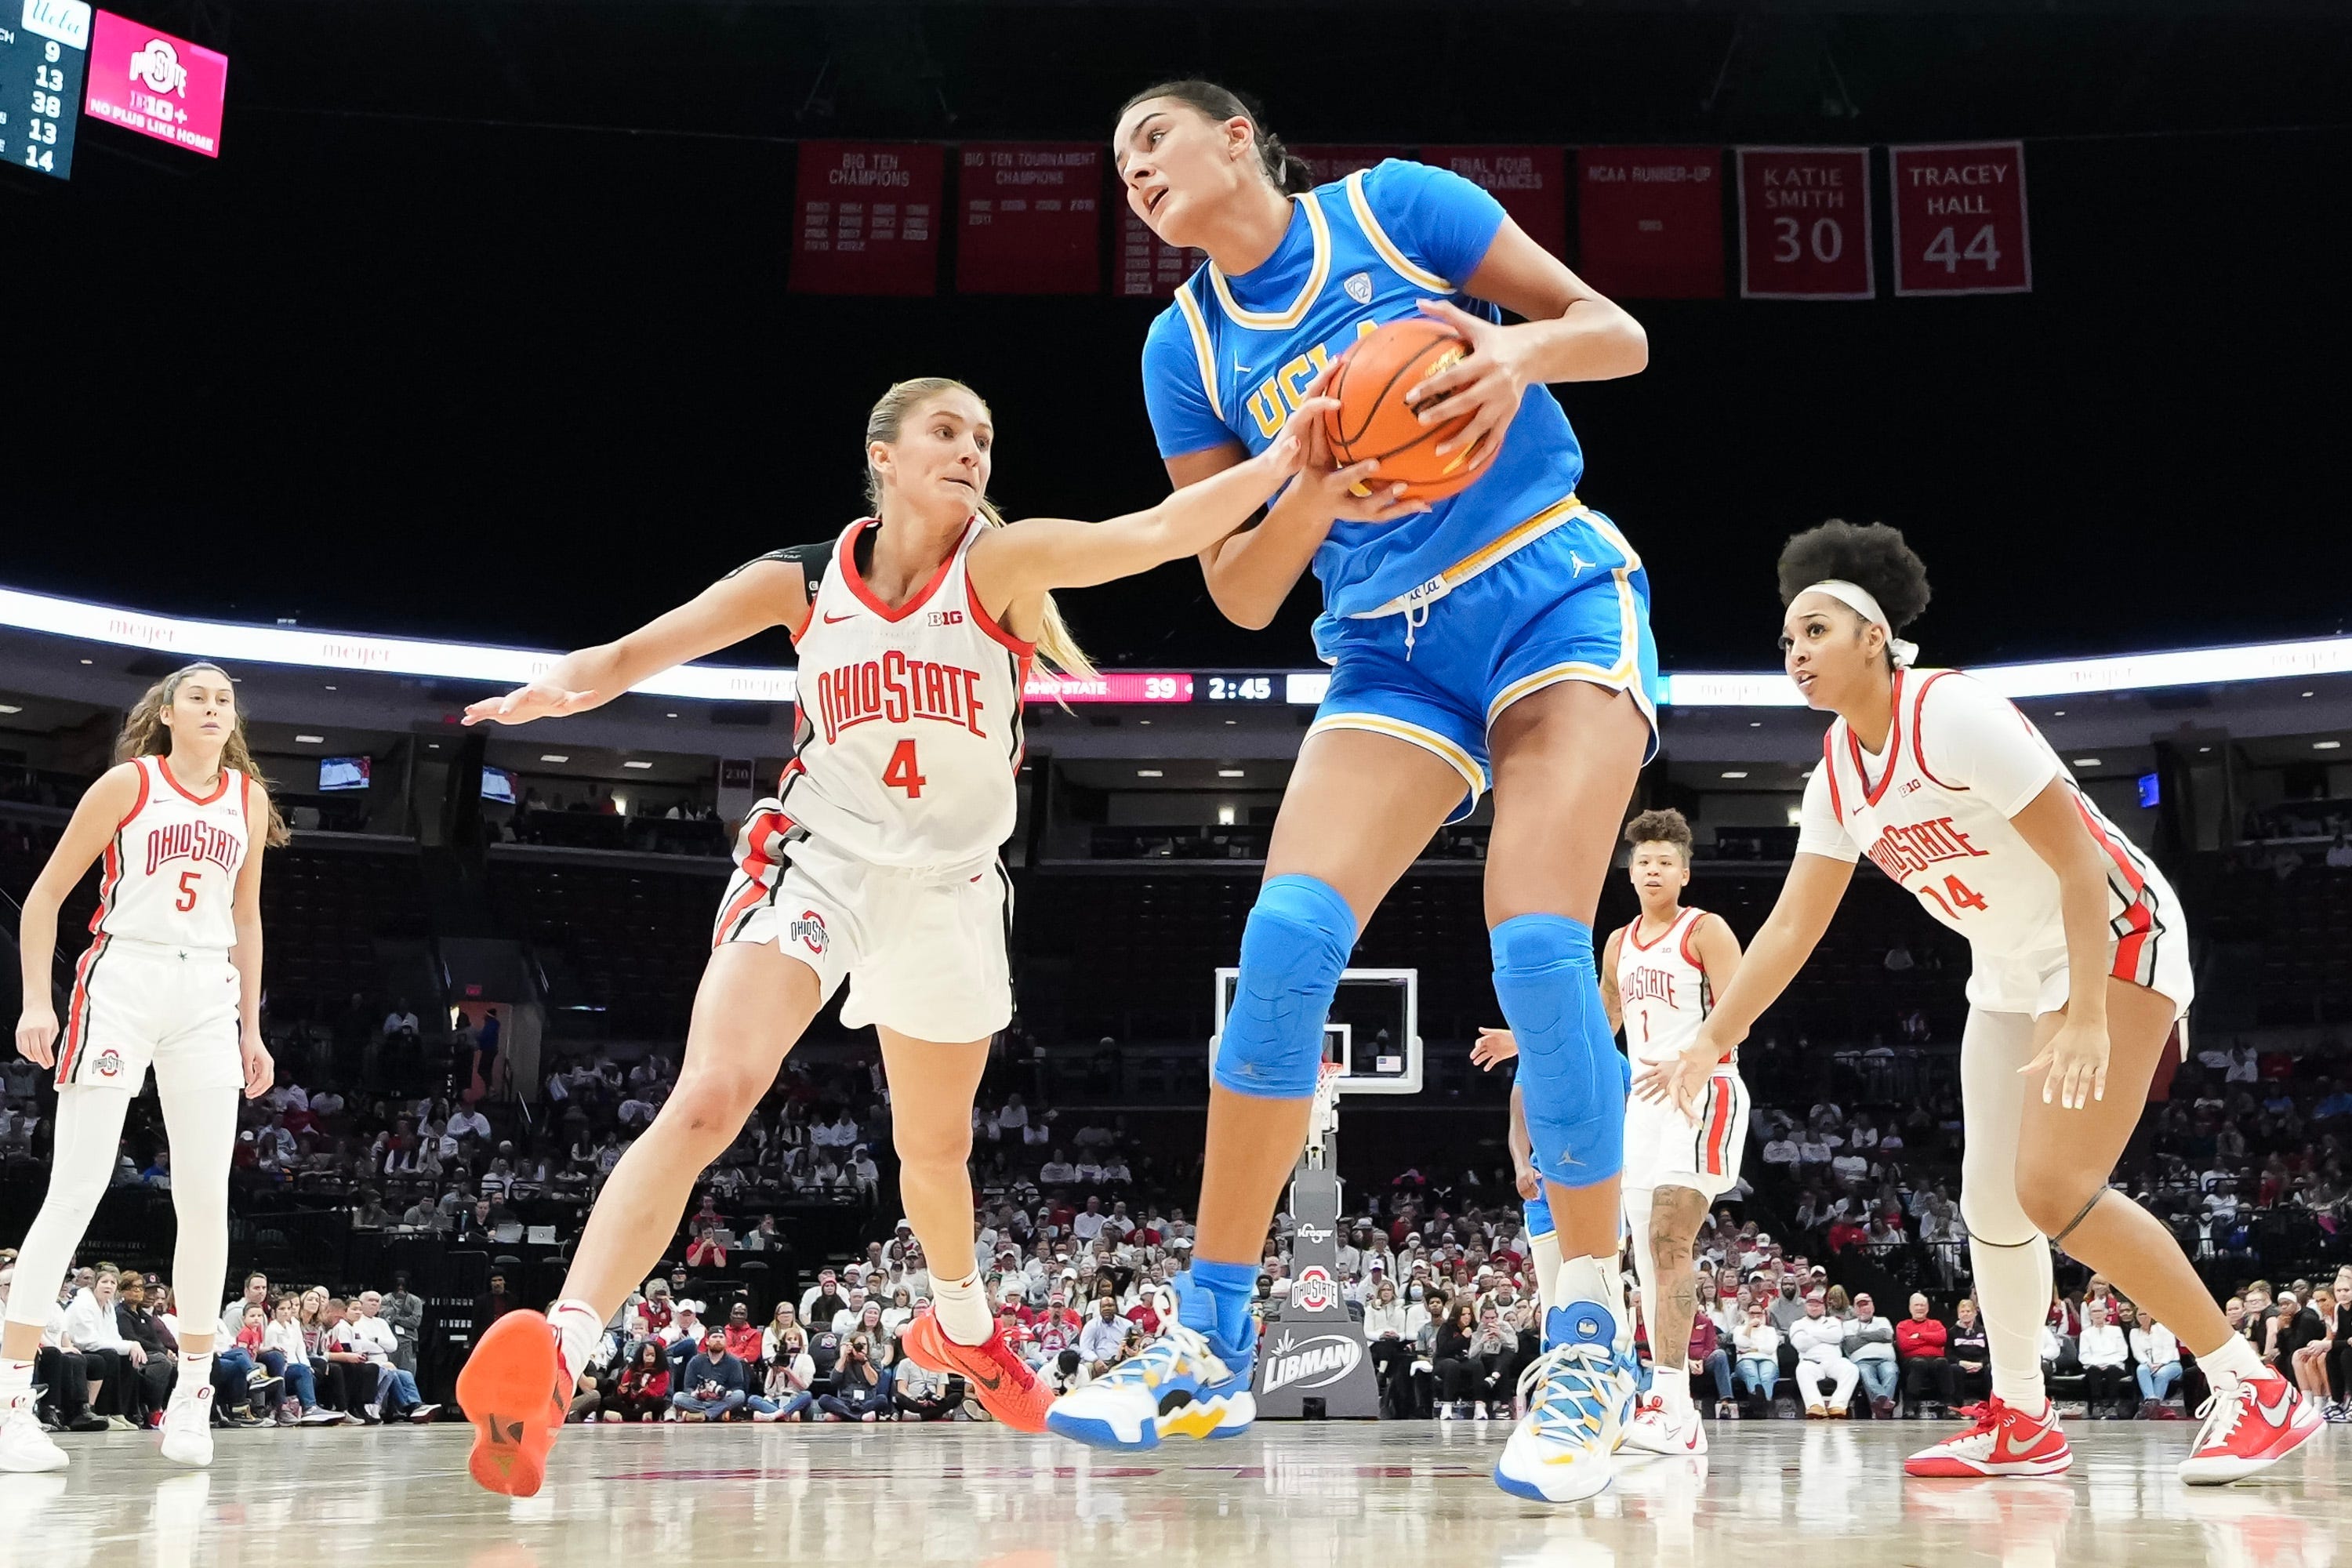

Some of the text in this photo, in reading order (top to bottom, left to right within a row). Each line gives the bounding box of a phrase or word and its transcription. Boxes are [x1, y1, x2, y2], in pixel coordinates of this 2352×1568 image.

[45, 41, 60, 63] 9
[35, 65, 64, 92] 13
[31, 91, 60, 118] 38
[28, 118, 57, 145] 13
[90, 98, 213, 151] NO PLUS LIKE HOME
[25, 145, 53, 172] 14
[842, 153, 898, 170] BIG TEN
[964, 152, 1096, 167] BIG TEN TOURNAMENT
[1450, 157, 1532, 173] FINAL FOUR
[829, 169, 910, 187] CHAMPIONS
[996, 170, 1065, 186] CHAMPIONS
[1588, 166, 1711, 183] NCAA RUNNER-UP
[1764, 168, 1842, 187] KATIE
[1908, 164, 2009, 187] TRACEY
[1764, 190, 1844, 209] SMITH
[1927, 194, 1992, 216] HALL
[1773, 217, 1842, 263] 30
[1923, 224, 2002, 274] 44
[1062, 681, 1107, 695] STATE
[1145, 677, 1177, 699] 39
[1209, 677, 1272, 699] 2:45
[882, 739, 926, 800] 4
[176, 871, 201, 913] 5
[1919, 874, 1989, 920] 14
[1640, 1009, 1649, 1043] 1
[1298, 1223, 1333, 1244] Kroger
[1261, 1341, 1353, 1395] LIBMAN
